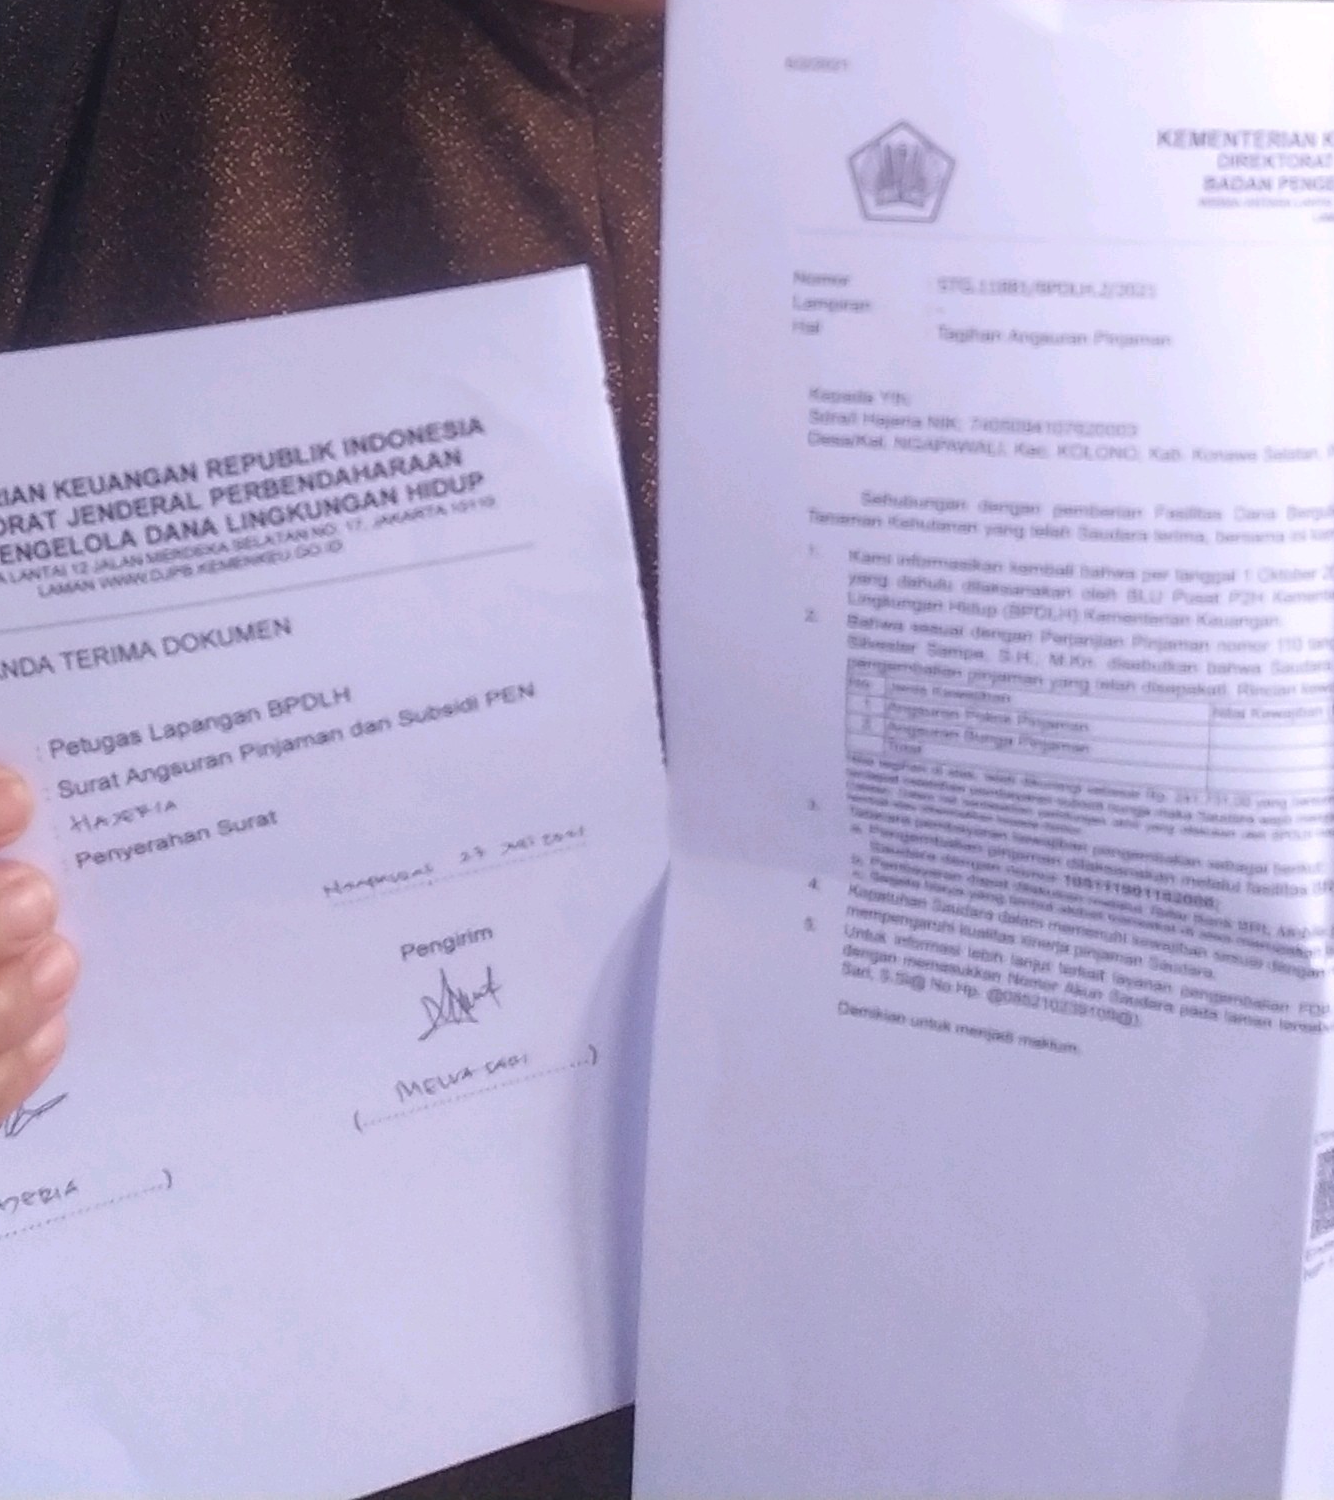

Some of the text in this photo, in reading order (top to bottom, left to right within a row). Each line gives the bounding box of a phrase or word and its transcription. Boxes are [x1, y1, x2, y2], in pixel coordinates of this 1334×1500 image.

[1158, 129, 1317, 150] KEMENTERIAN
[1204, 176, 1270, 191] BADAN
[52, 461, 199, 500] KEUANGAN
[207, 441, 333, 478] REPUBLIK
[342, 416, 485, 454] INDONESIA
[67, 491, 202, 528] JENDERAL
[209, 448, 461, 507] PERBENDAHARAAN
[145, 511, 218, 545] DANA
[226, 486, 397, 533] LINGKUNGAN
[406, 471, 485, 506] HIDUP
[60, 641, 156, 672] TERIMA
[162, 617, 292, 659] DOKUMEN
[49, 686, 352, 762] Petugas Lapangan BPDLH
[57, 683, 536, 800] Surat Angsuran Pinjaman dan Subsidi PEN
[75, 810, 278, 871] Penyerahan Surat
[401, 927, 494, 962] Pengirim
